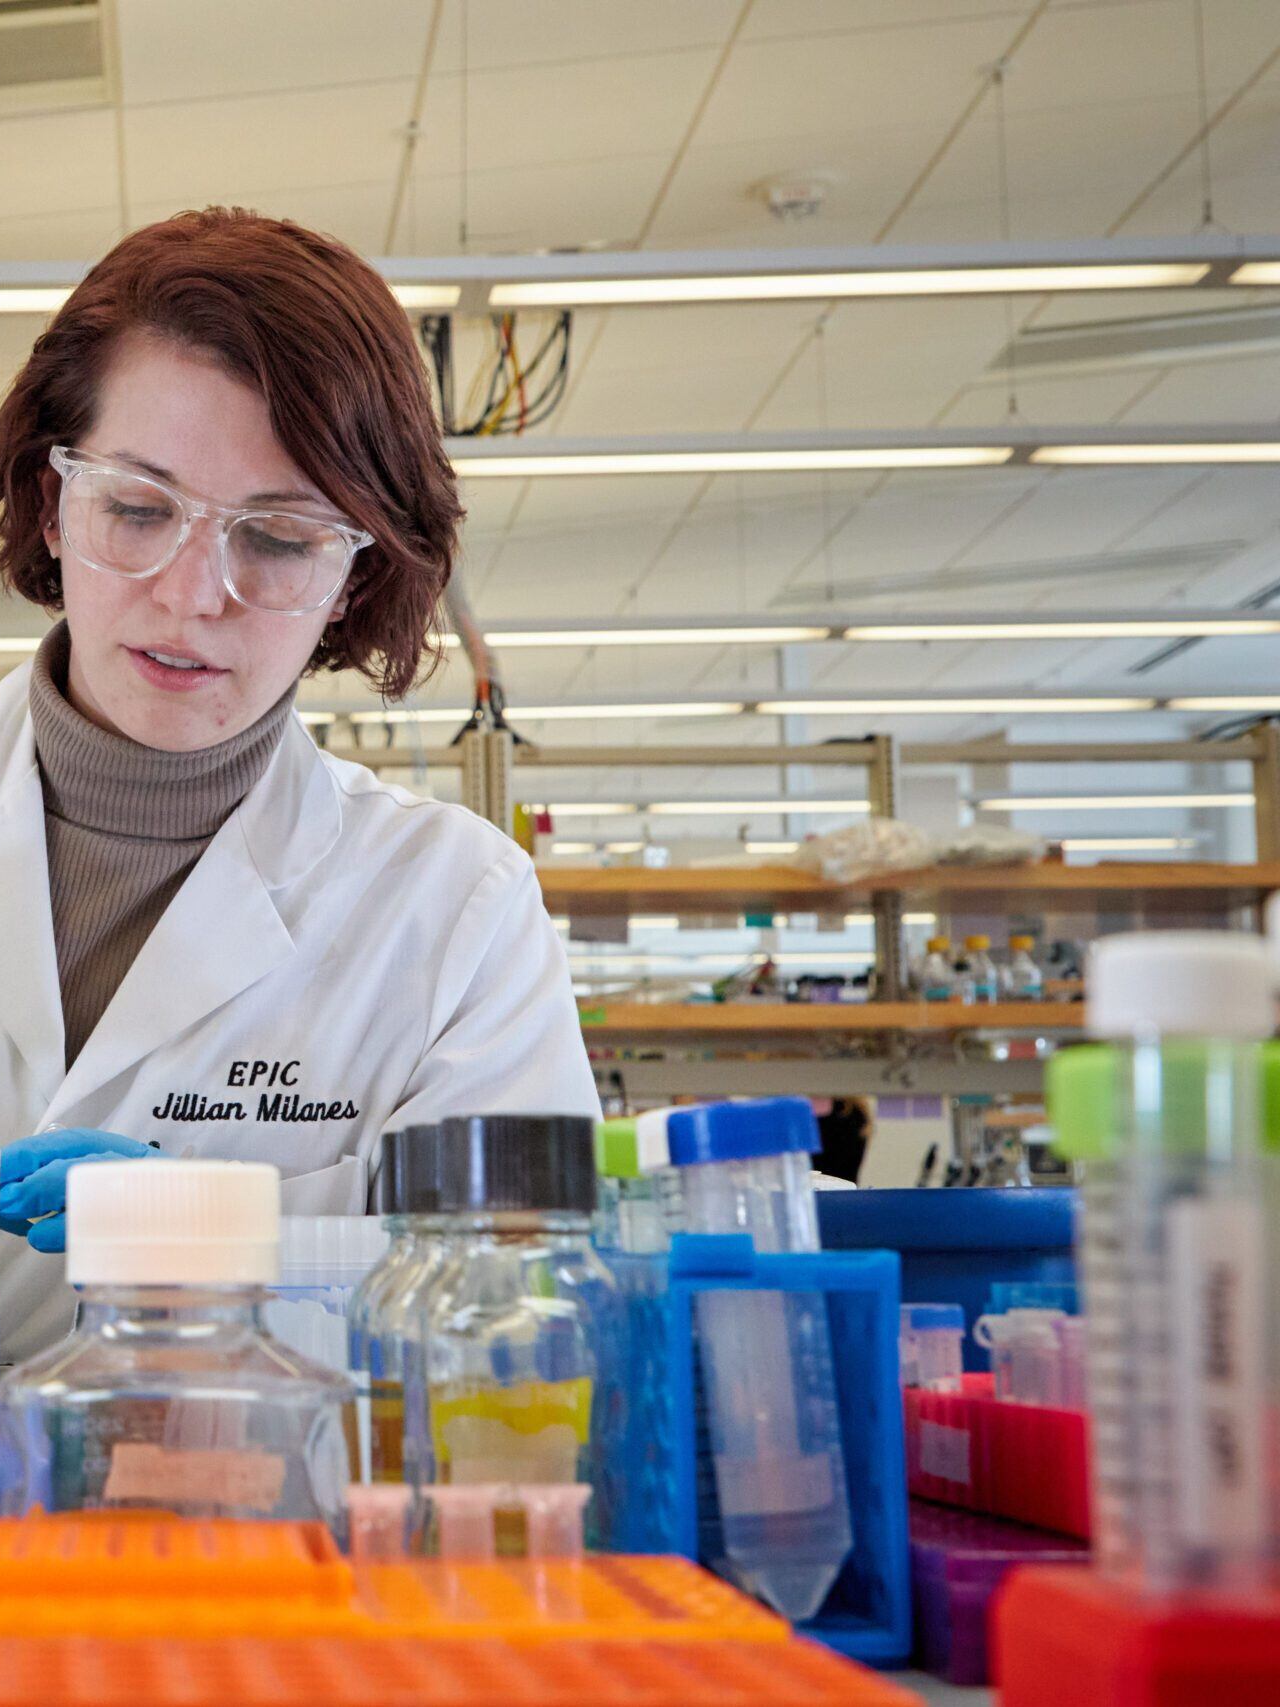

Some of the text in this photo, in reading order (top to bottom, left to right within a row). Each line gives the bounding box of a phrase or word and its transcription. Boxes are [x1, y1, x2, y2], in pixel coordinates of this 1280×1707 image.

[227, 1060, 301, 1087] EPIC
[152, 1093, 360, 1122] Jillian Milanes
